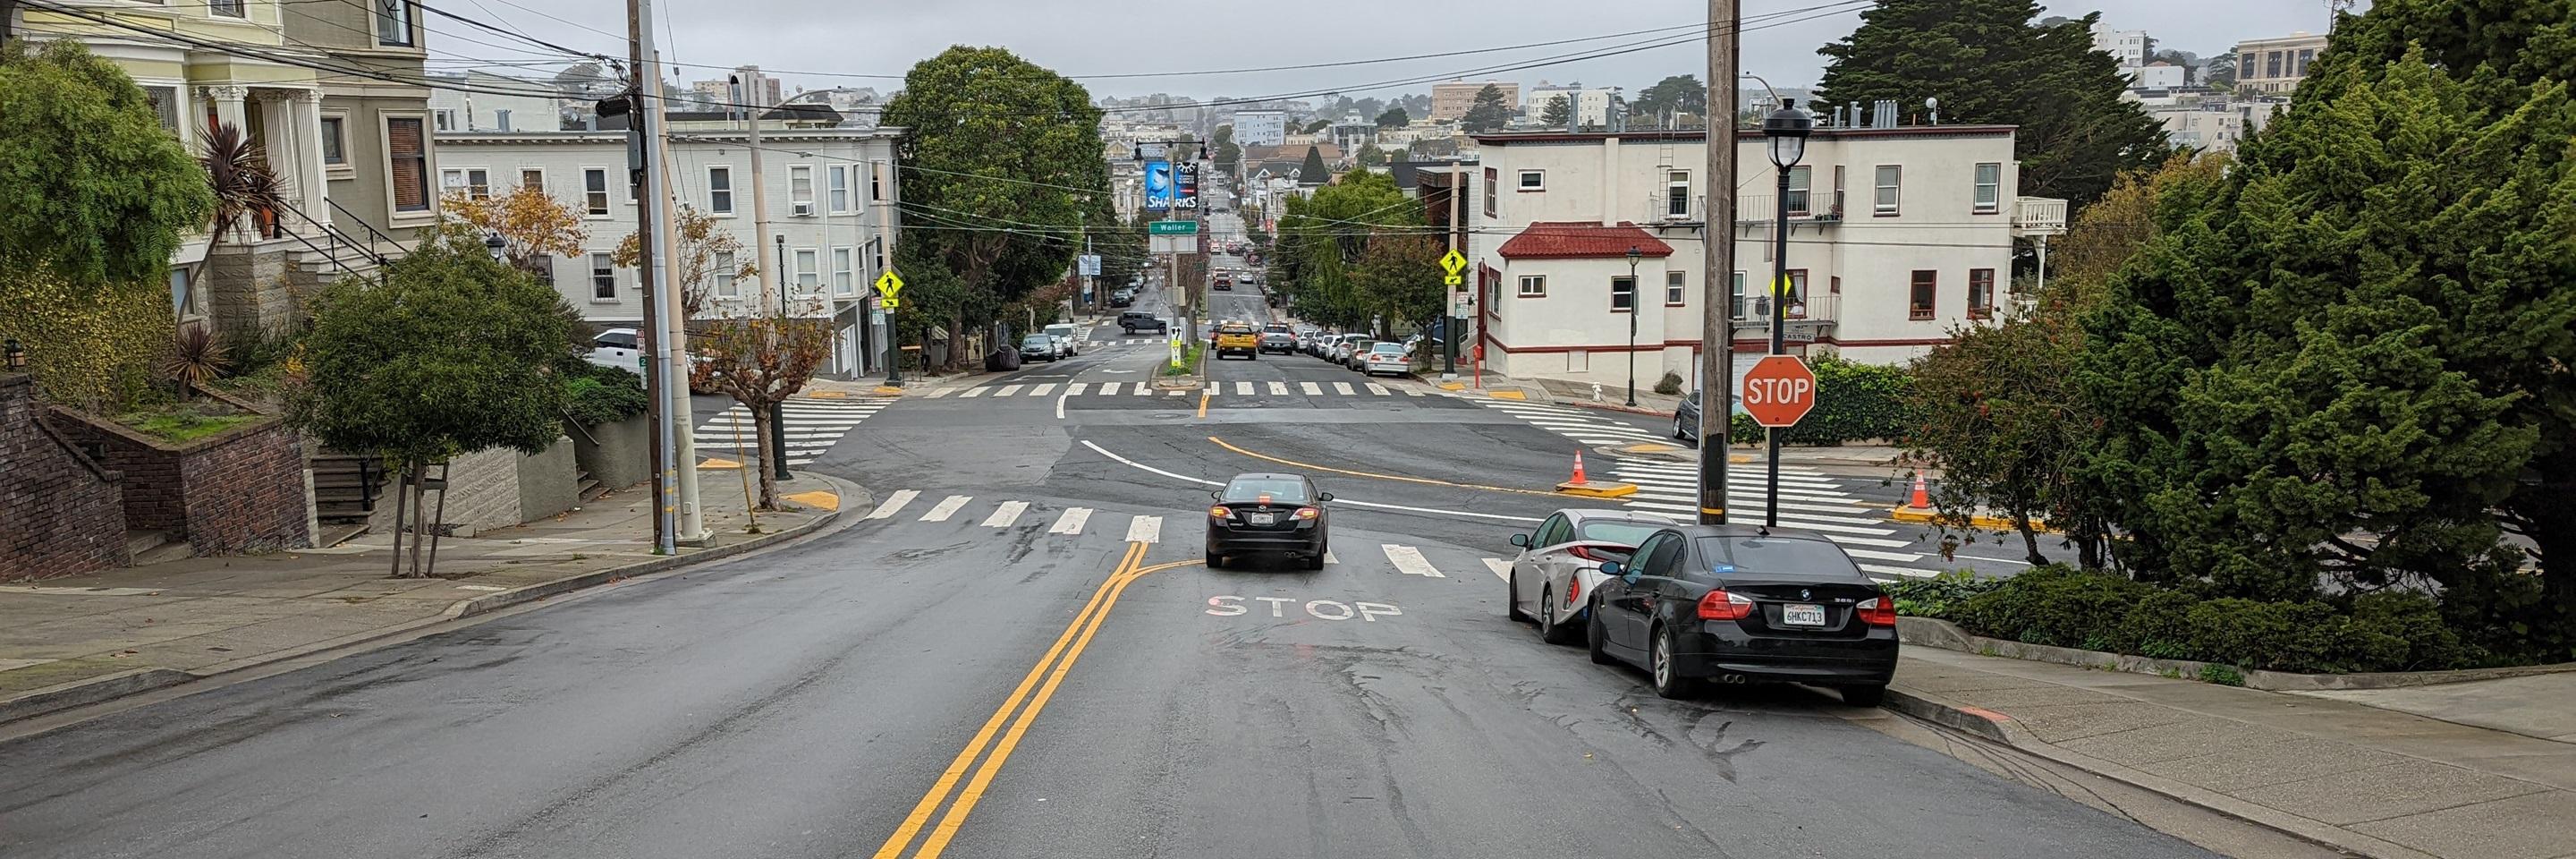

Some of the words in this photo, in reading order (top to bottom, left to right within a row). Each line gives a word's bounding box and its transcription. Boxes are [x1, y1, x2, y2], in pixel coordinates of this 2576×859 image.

[1748, 378, 1809, 404] STOP
[1206, 595, 1402, 622] STOP
[1787, 611, 1822, 624] 6HKC713
